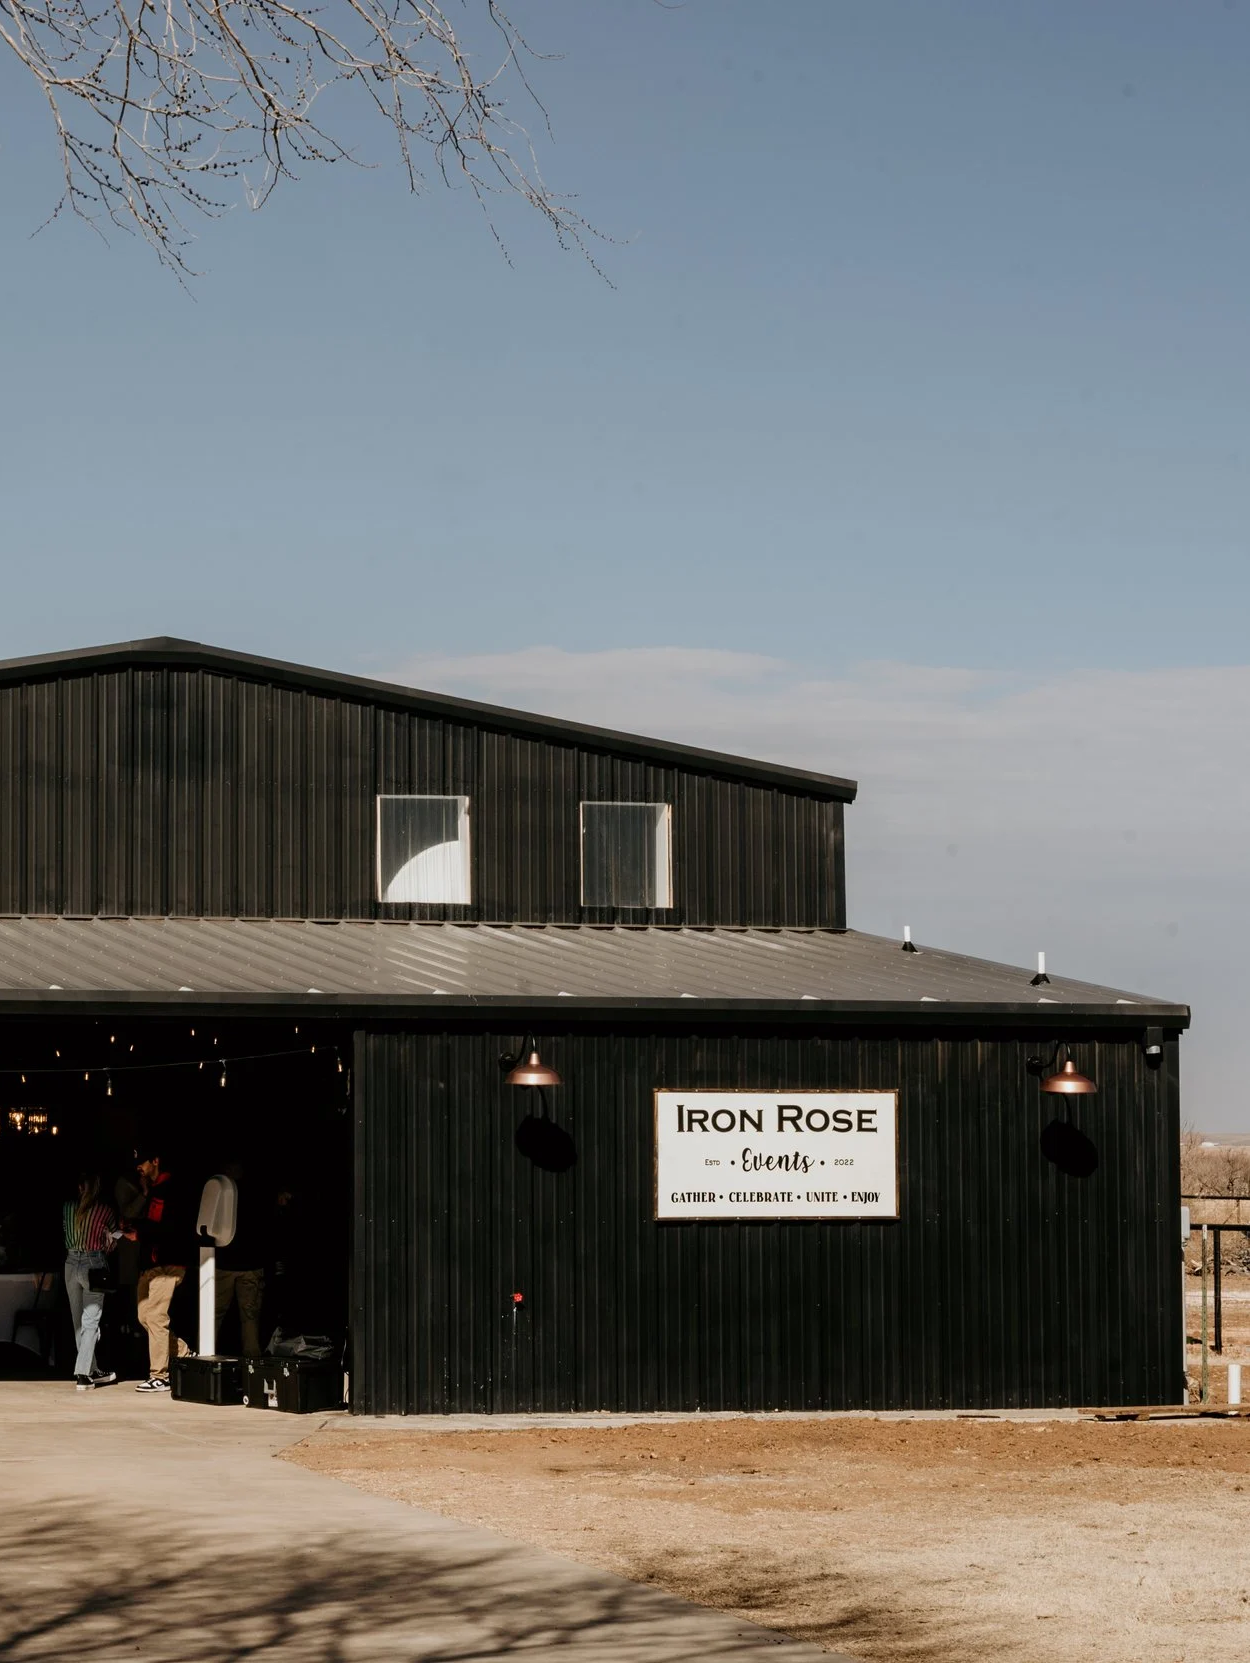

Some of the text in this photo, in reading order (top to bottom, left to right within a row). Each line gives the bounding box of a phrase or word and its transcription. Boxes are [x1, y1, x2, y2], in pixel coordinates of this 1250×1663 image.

[676, 1104, 878, 1134] IRON ROSE
[741, 1147, 816, 1174] Events
[834, 1158, 854, 1166] 2022
[670, 1191, 881, 1205] GATHER CELEBRATE UNITE ENJOY
